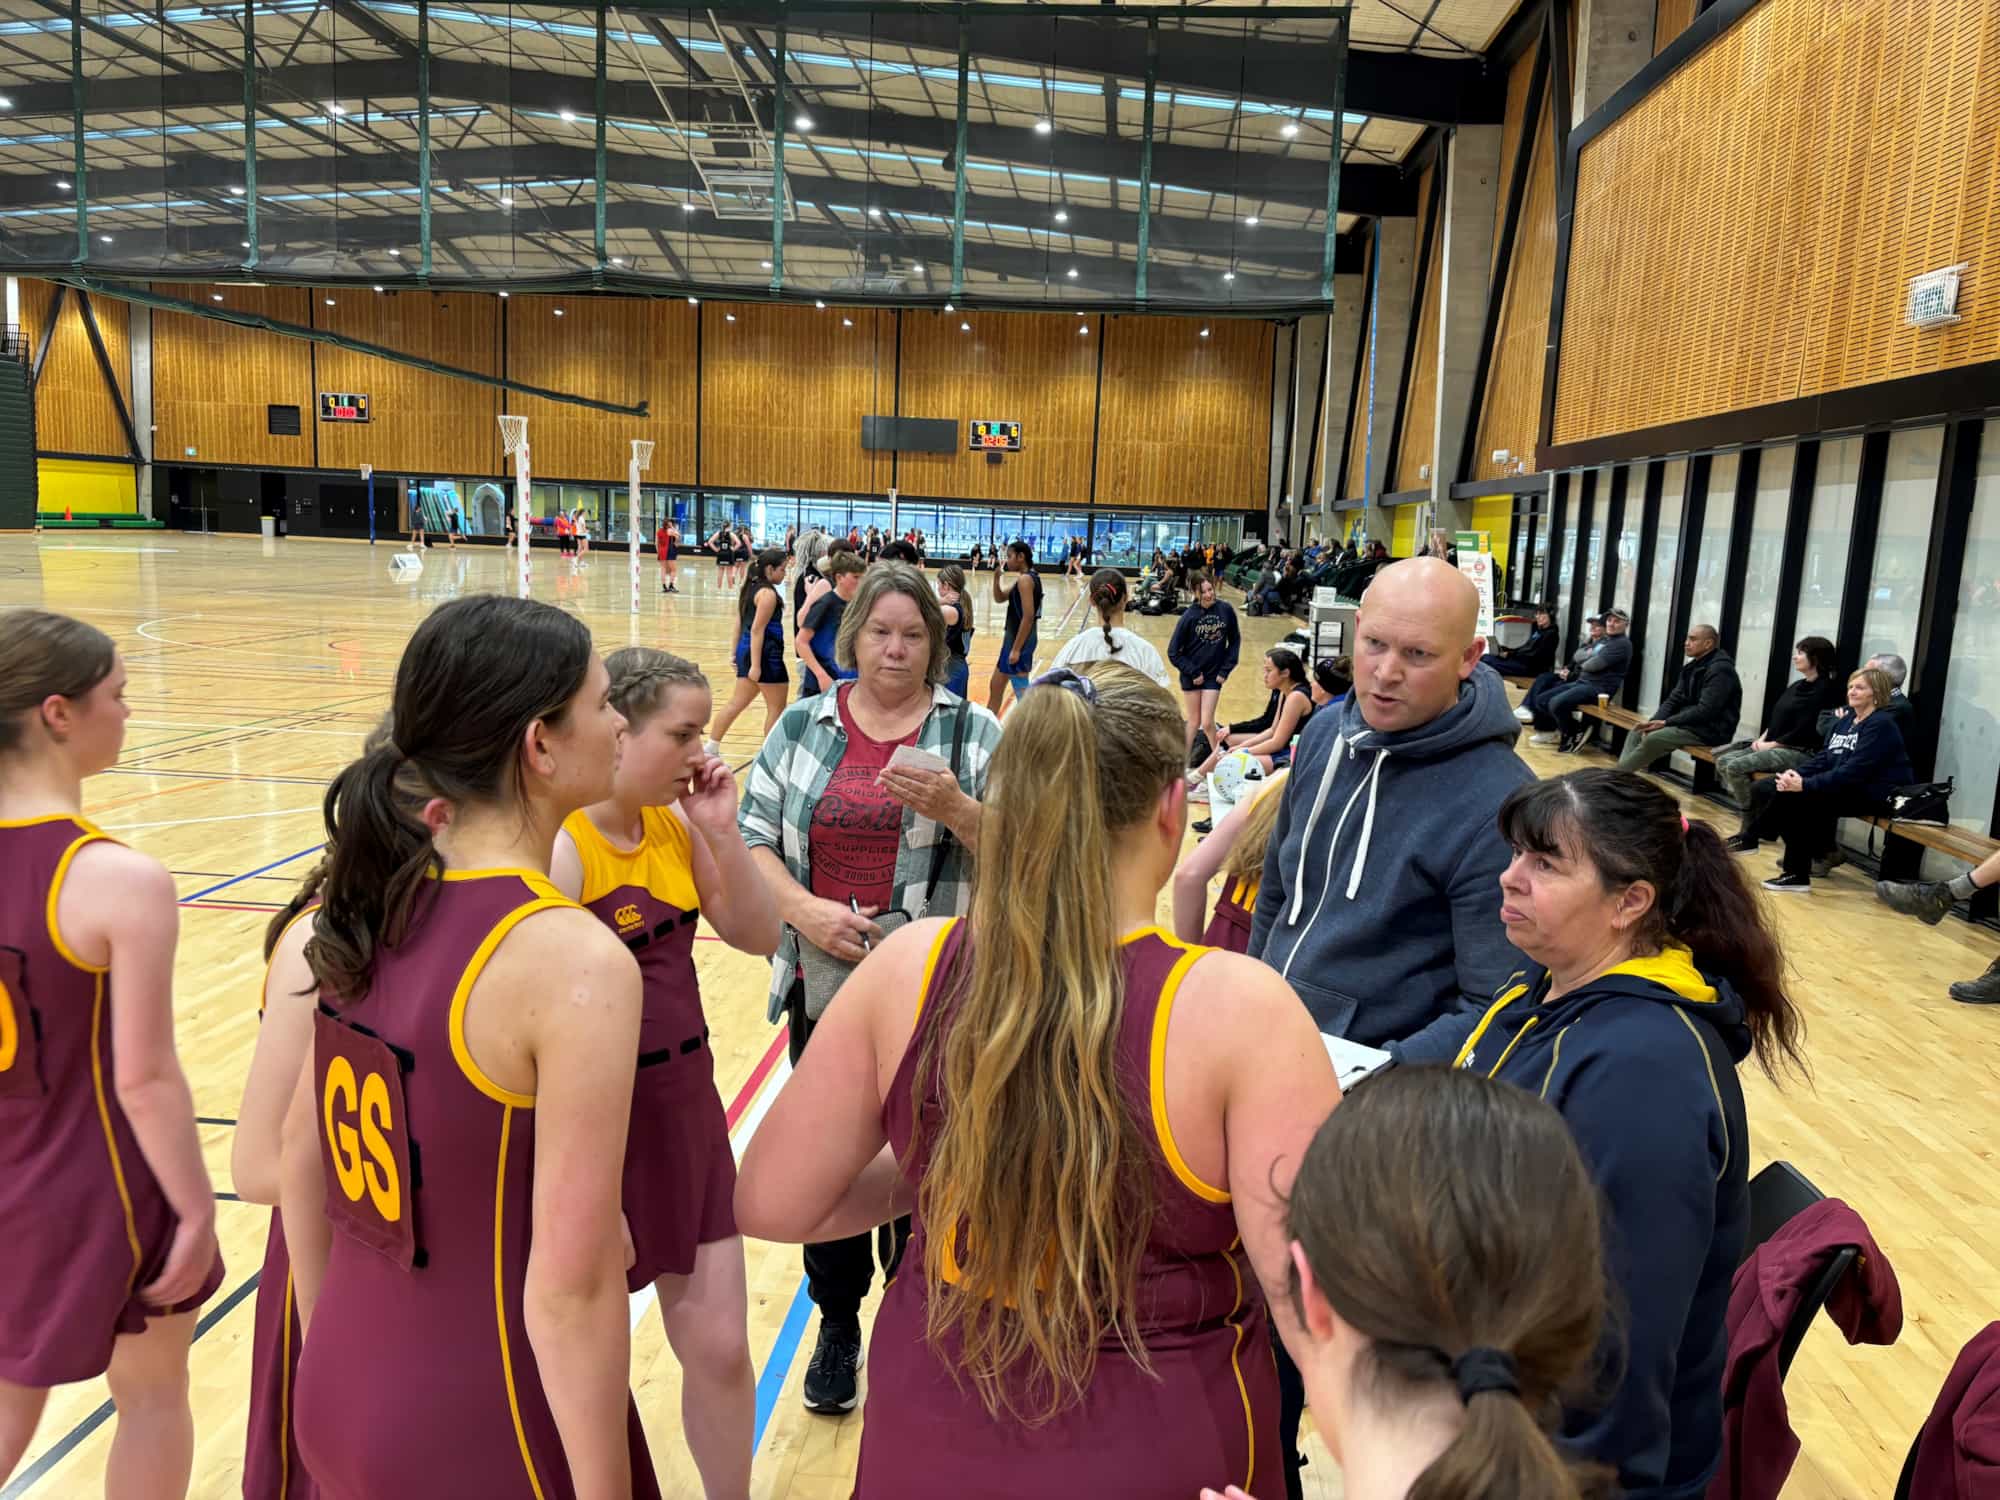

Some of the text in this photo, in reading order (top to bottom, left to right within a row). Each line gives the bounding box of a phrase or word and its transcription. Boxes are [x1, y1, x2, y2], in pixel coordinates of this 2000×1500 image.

[329, 397, 335, 408] 0
[359, 399, 365, 408] 0
[324, 1055, 401, 1222] GS
